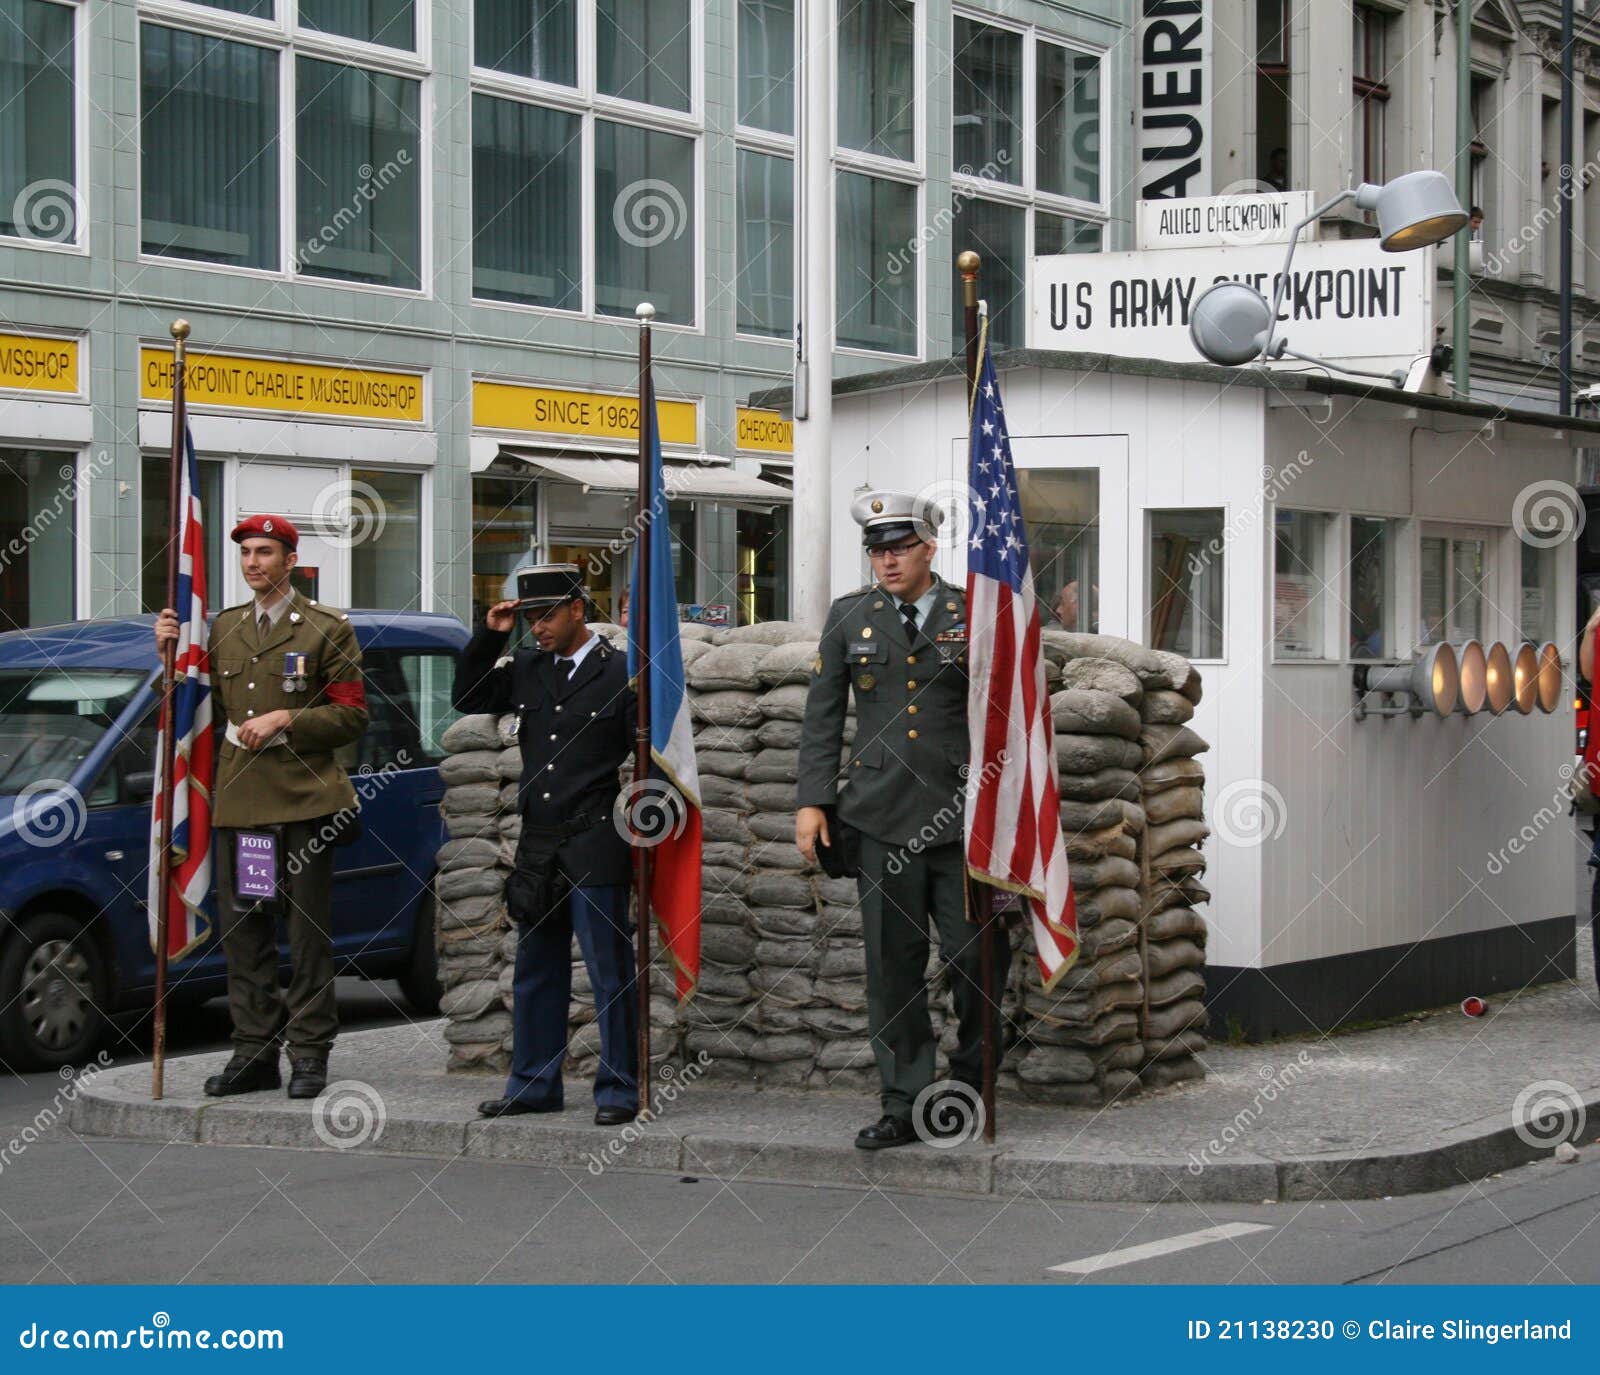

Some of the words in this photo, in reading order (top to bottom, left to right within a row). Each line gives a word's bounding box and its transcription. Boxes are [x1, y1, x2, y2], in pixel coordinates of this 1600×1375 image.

[1159, 206, 1201, 236] ALLIED
[1207, 202, 1289, 233] CHECKPOINT
[1109, 276, 1197, 328] ARMY
[1212, 266, 1406, 323] CKPOINT
[245, 370, 304, 400] CHARLIE
[309, 376, 416, 410] MUSEUMSSHOP
[534, 398, 590, 427] SINCE
[597, 404, 640, 430] 1962
[241, 837, 272, 850] FOTO
